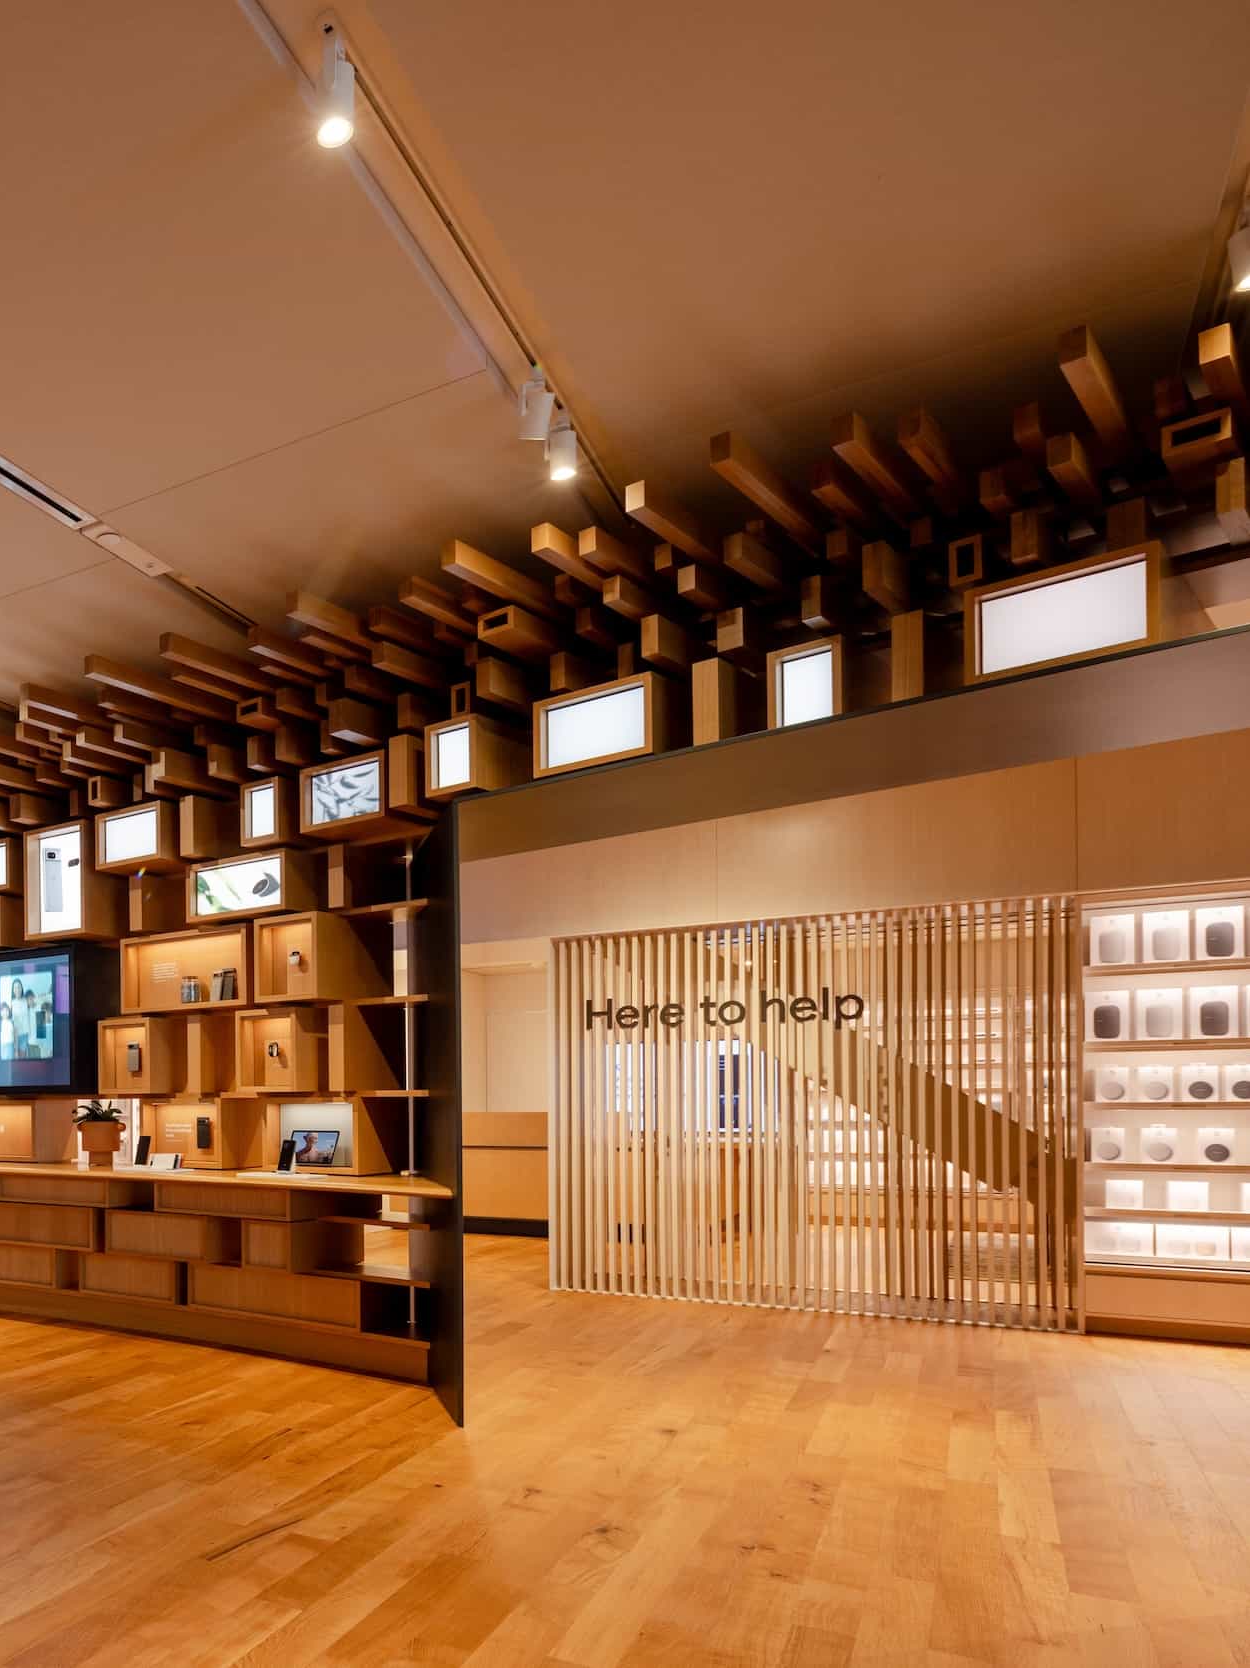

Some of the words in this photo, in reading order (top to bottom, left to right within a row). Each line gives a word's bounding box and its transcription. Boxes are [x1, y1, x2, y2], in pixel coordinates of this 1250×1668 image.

[585, 997, 686, 1031] Here
[700, 995, 747, 1027] to
[760, 986, 866, 1031] help
